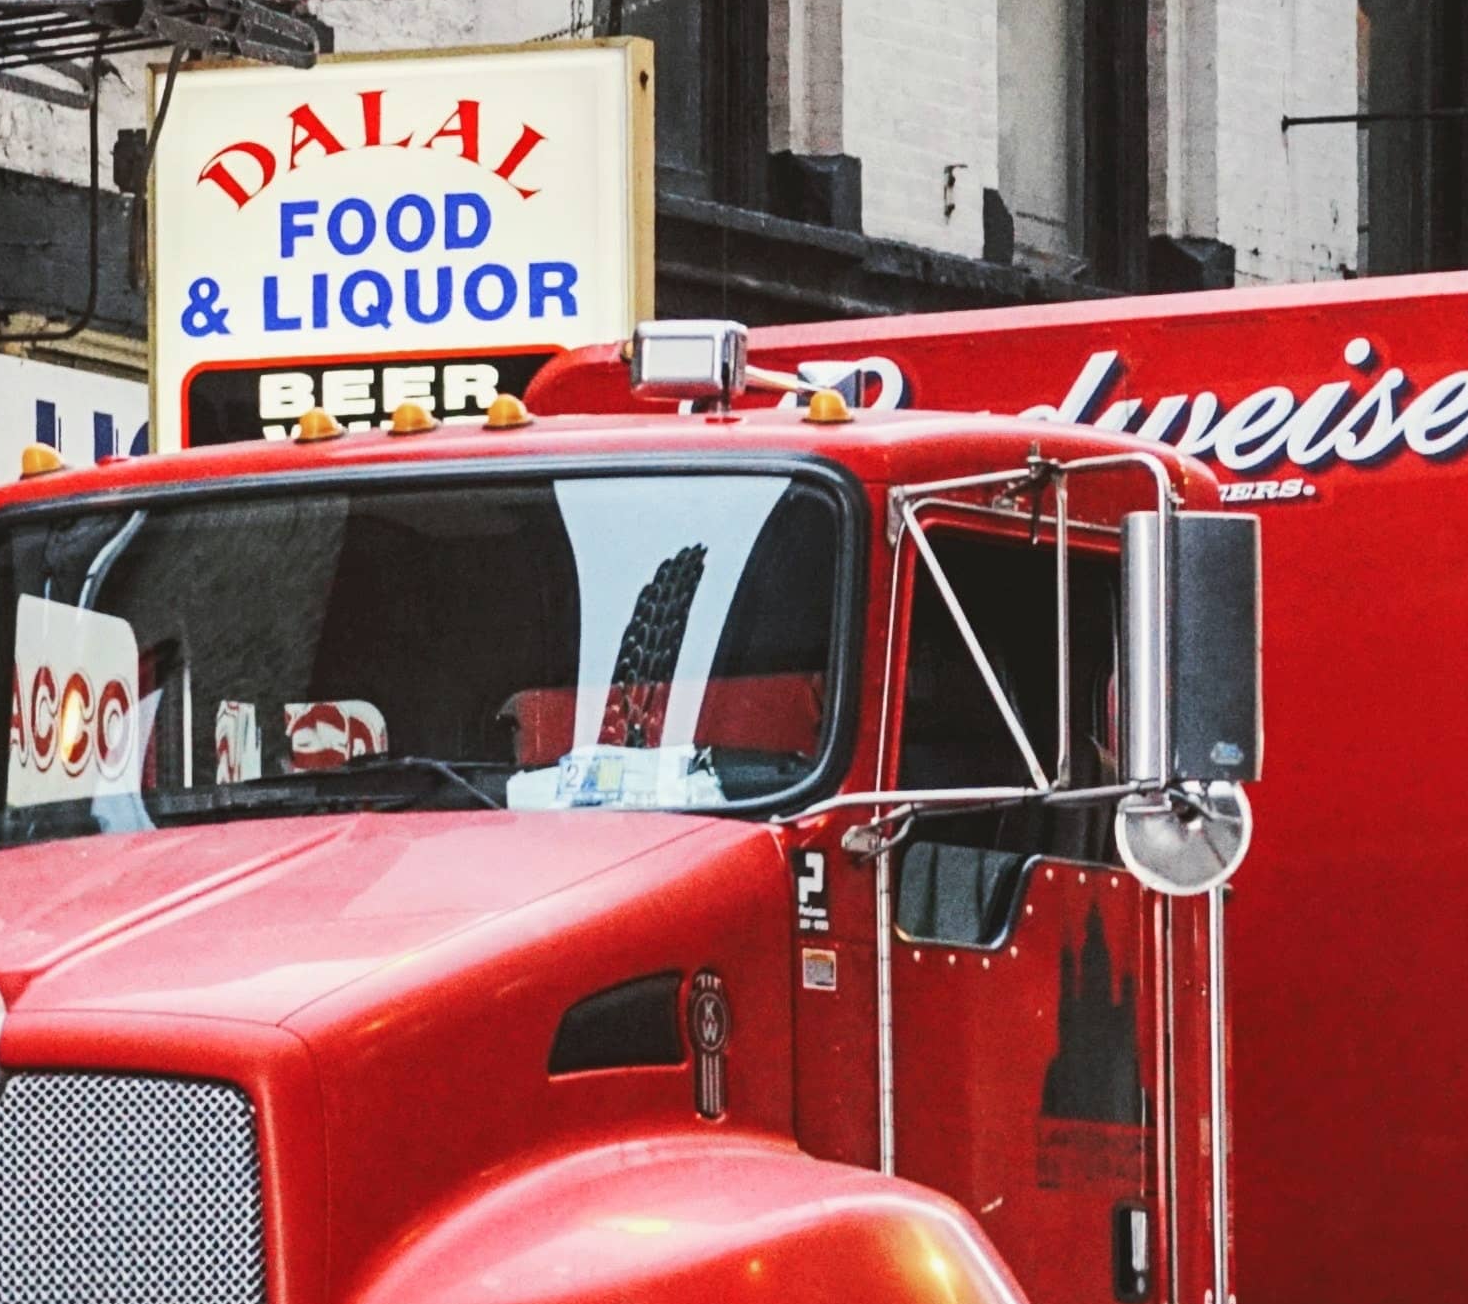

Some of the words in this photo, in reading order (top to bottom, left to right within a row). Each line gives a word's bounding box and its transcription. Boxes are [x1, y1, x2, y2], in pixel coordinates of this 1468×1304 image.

[197, 89, 548, 210] DALAL
[279, 192, 492, 259] FOOD
[180, 277, 234, 337] &
[262, 261, 579, 332] LIQUOR
[258, 363, 499, 419] BEER
